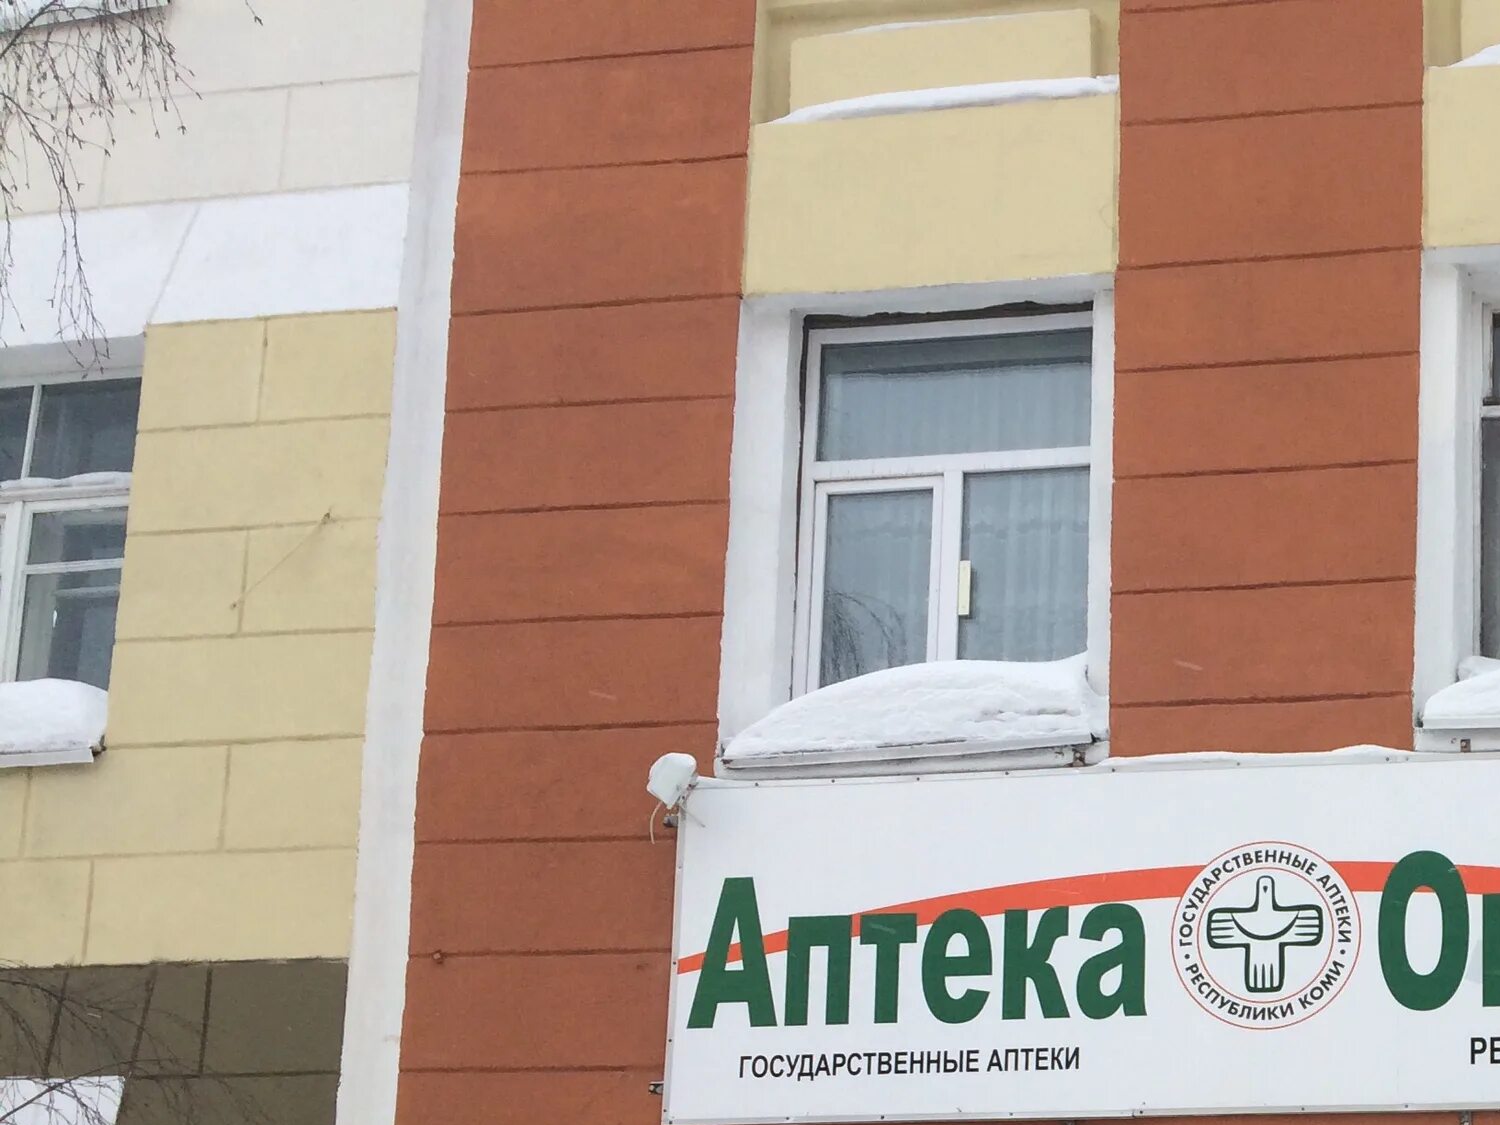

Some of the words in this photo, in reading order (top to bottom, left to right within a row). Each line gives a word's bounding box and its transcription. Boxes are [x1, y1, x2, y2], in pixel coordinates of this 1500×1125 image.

[1179, 850, 1318, 947] ГОСУДАРСТВЕННЫЕ
[1316, 874, 1352, 943] АПТЕКИ
[686, 876, 1148, 1029] Аптека
[1185, 963, 1295, 1021] РЕСПУБЛИКИ
[1298, 960, 1346, 1010] КОМИ
[738, 1049, 980, 1082] ГОСУДАРСТВЕННЫЕ
[986, 1046, 1081, 1073] АПТЕКИ
